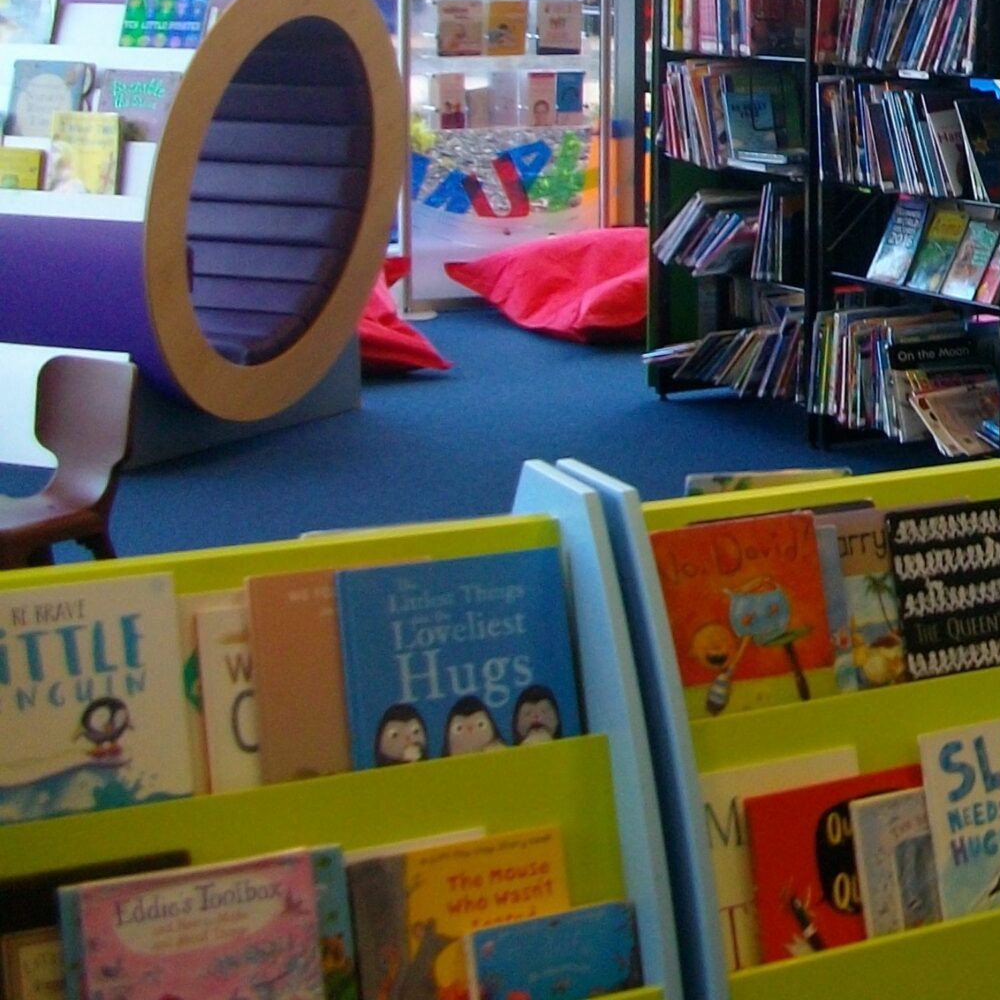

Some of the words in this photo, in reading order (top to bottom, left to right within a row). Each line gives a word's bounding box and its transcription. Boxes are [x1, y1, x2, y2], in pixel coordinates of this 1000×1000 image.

[898, 350, 915, 362] On
[917, 348, 936, 361] the
[938, 346, 970, 358] Moon
[391, 610, 528, 651] Loveliest
[915, 624, 939, 645] THE
[395, 648, 534, 708] Hugs
[196, 880, 284, 912] Toolbox
